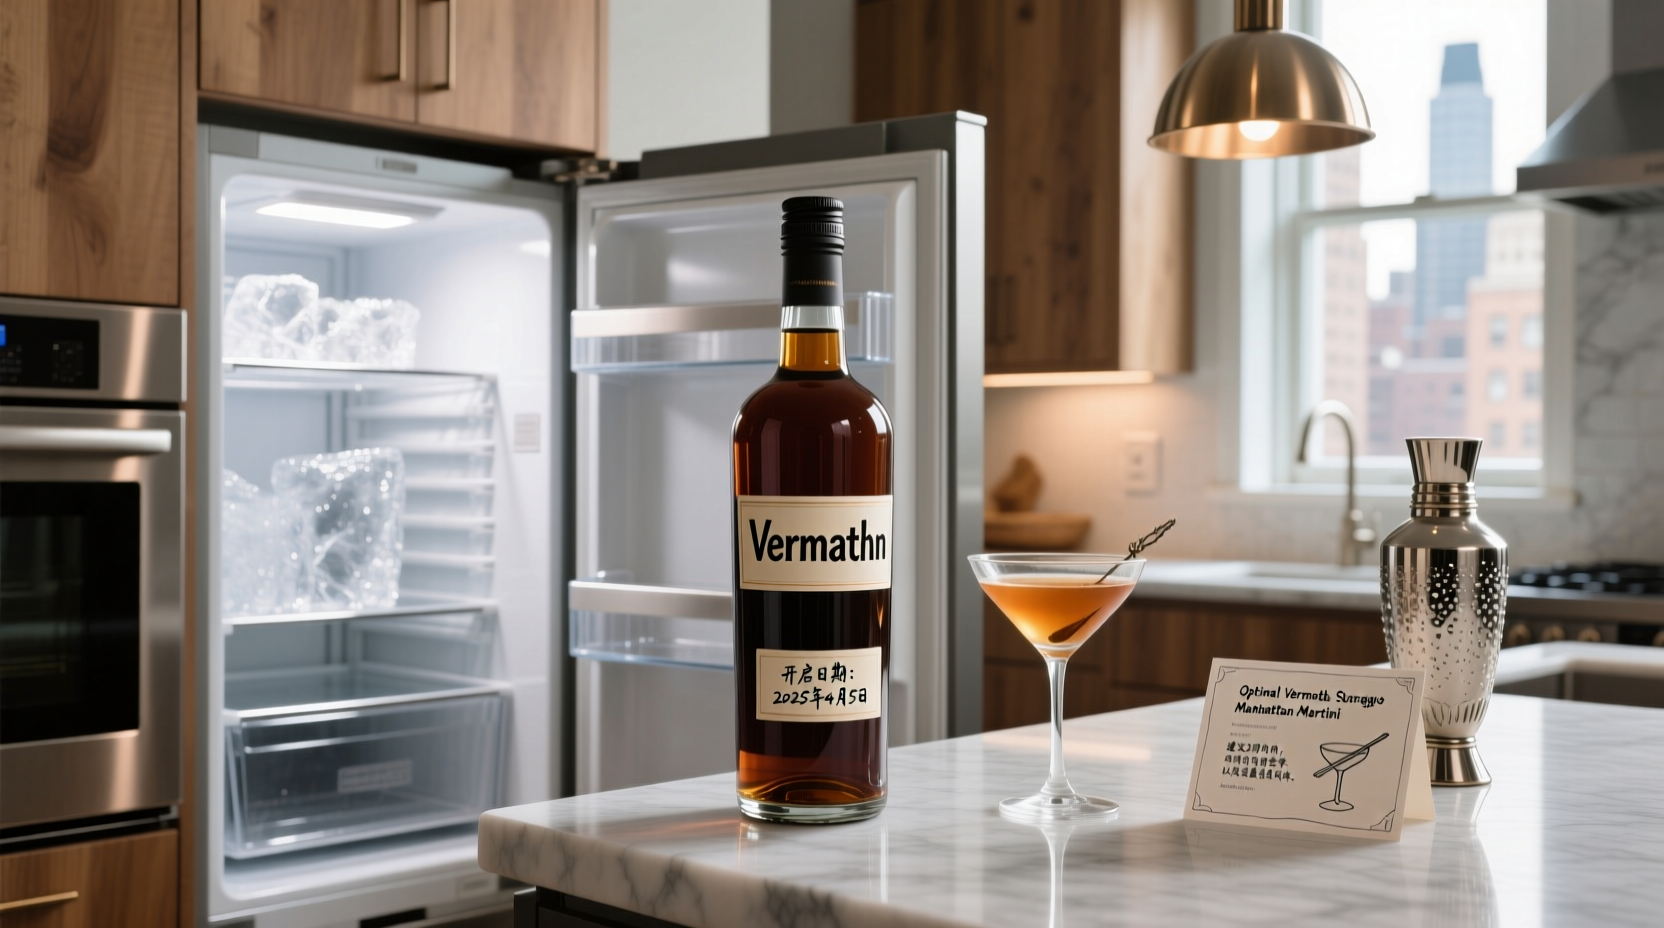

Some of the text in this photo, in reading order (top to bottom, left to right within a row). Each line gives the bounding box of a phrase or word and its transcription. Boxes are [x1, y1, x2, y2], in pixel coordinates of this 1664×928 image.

[749, 519, 886, 562] Vermathn
[773, 687, 867, 710] 2025年4月5日
[1296, 705, 1342, 719] Martini
